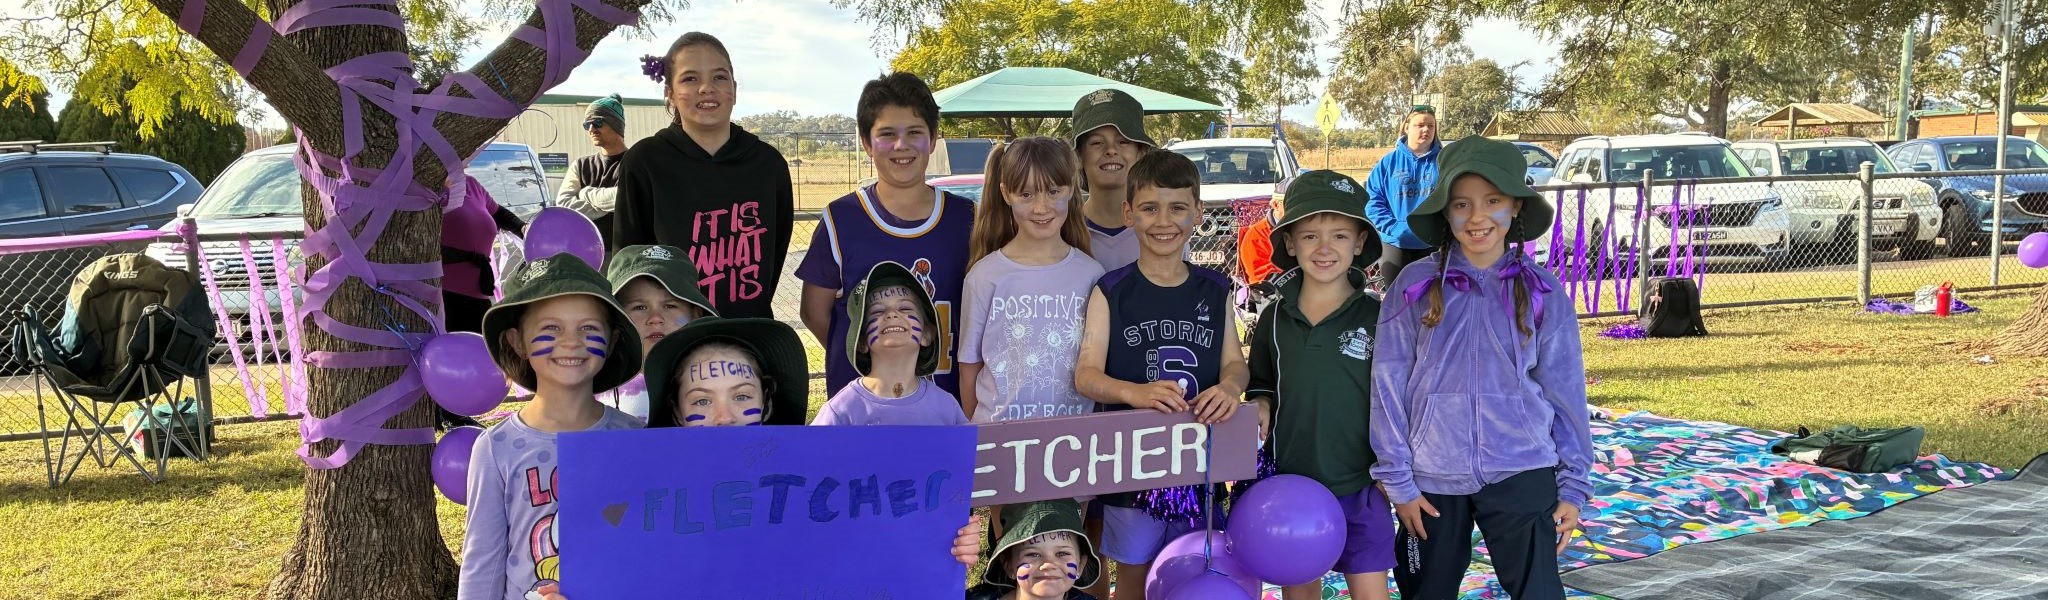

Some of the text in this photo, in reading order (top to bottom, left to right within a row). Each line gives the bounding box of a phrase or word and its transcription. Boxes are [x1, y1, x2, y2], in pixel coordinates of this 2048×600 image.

[692, 201, 761, 243] IT IS
[688, 227, 767, 275] WHAT
[103, 271, 139, 280] KINGS
[697, 264, 763, 308] T IS
[869, 286, 911, 302] LETCHER
[1123, 320, 1214, 348] STORM
[690, 360, 756, 382] FLETCHER
[971, 422, 1207, 498] ETCHER
[1028, 531, 1072, 545] LETCHER
